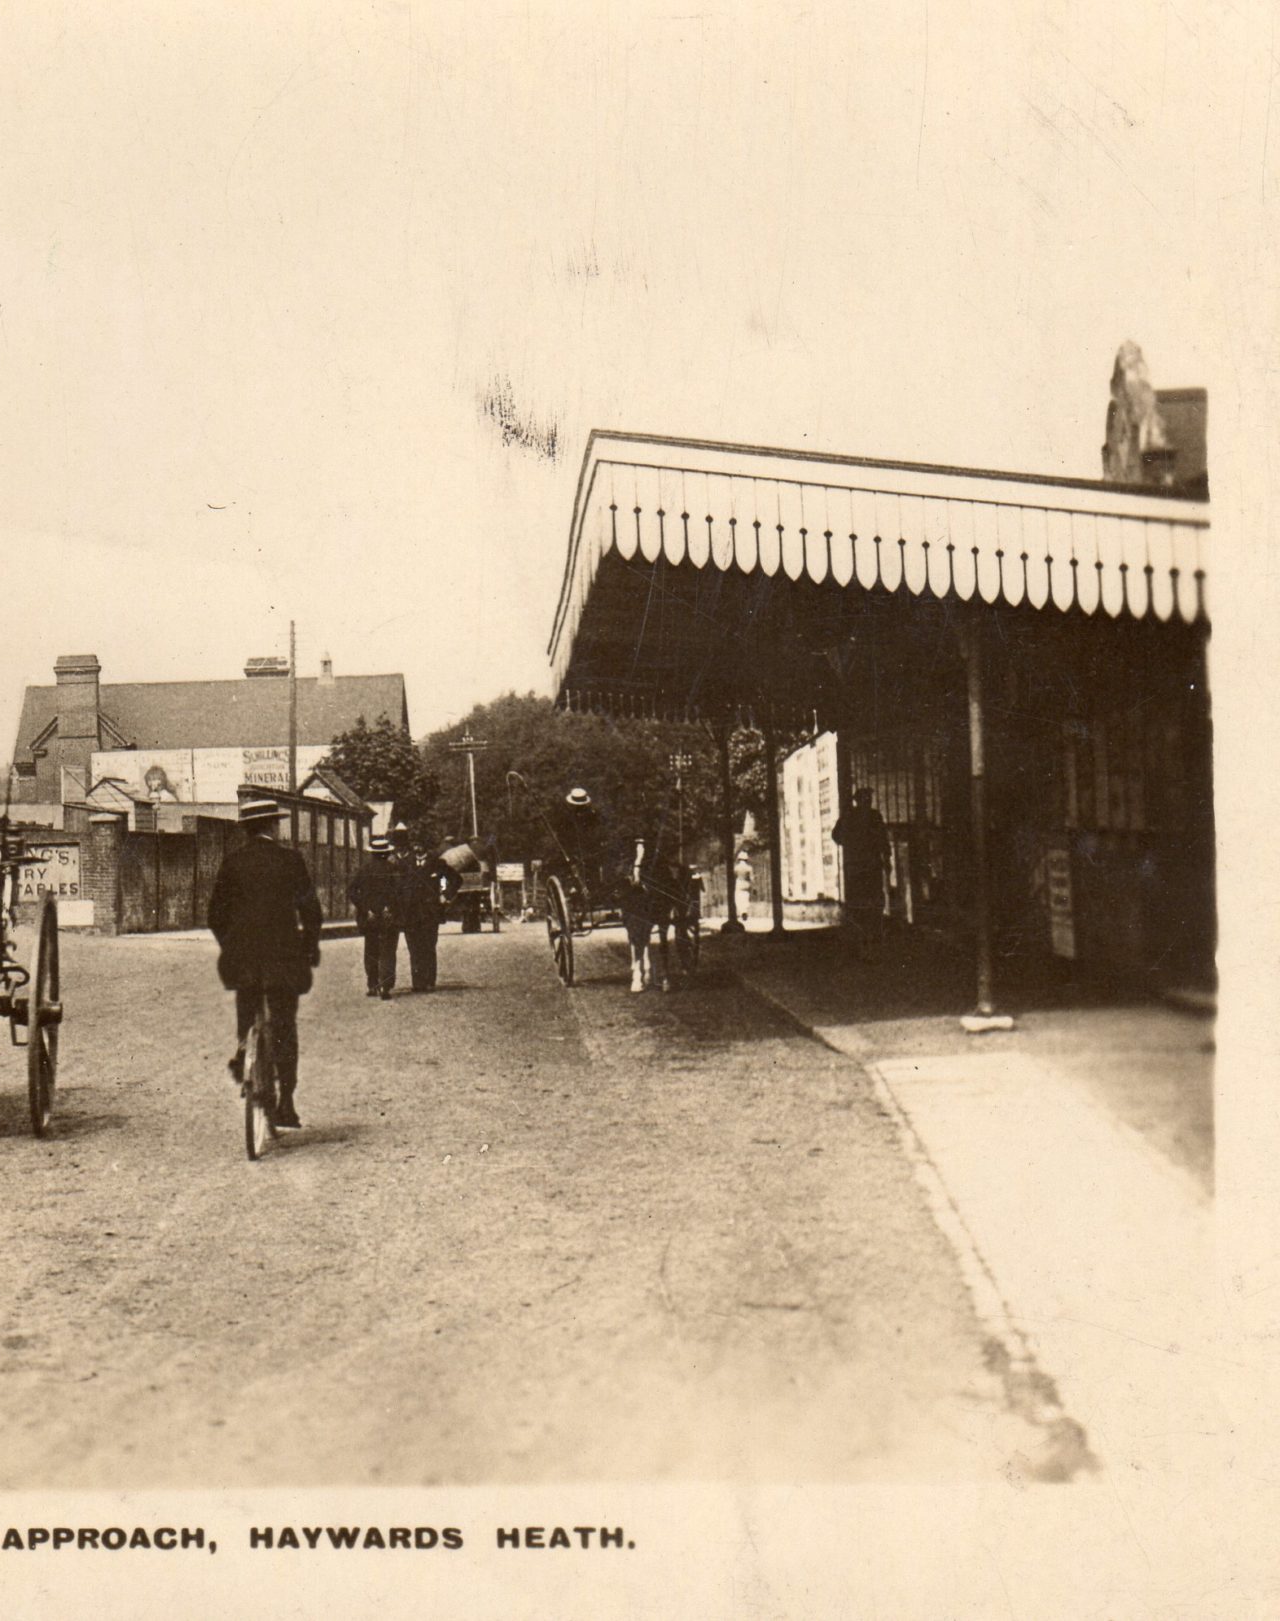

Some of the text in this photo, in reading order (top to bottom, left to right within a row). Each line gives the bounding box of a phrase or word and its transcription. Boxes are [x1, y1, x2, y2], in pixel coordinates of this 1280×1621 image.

[23, 847, 76, 866] NG'S.
[24, 868, 47, 880] RY
[19, 883, 79, 896] ABLES
